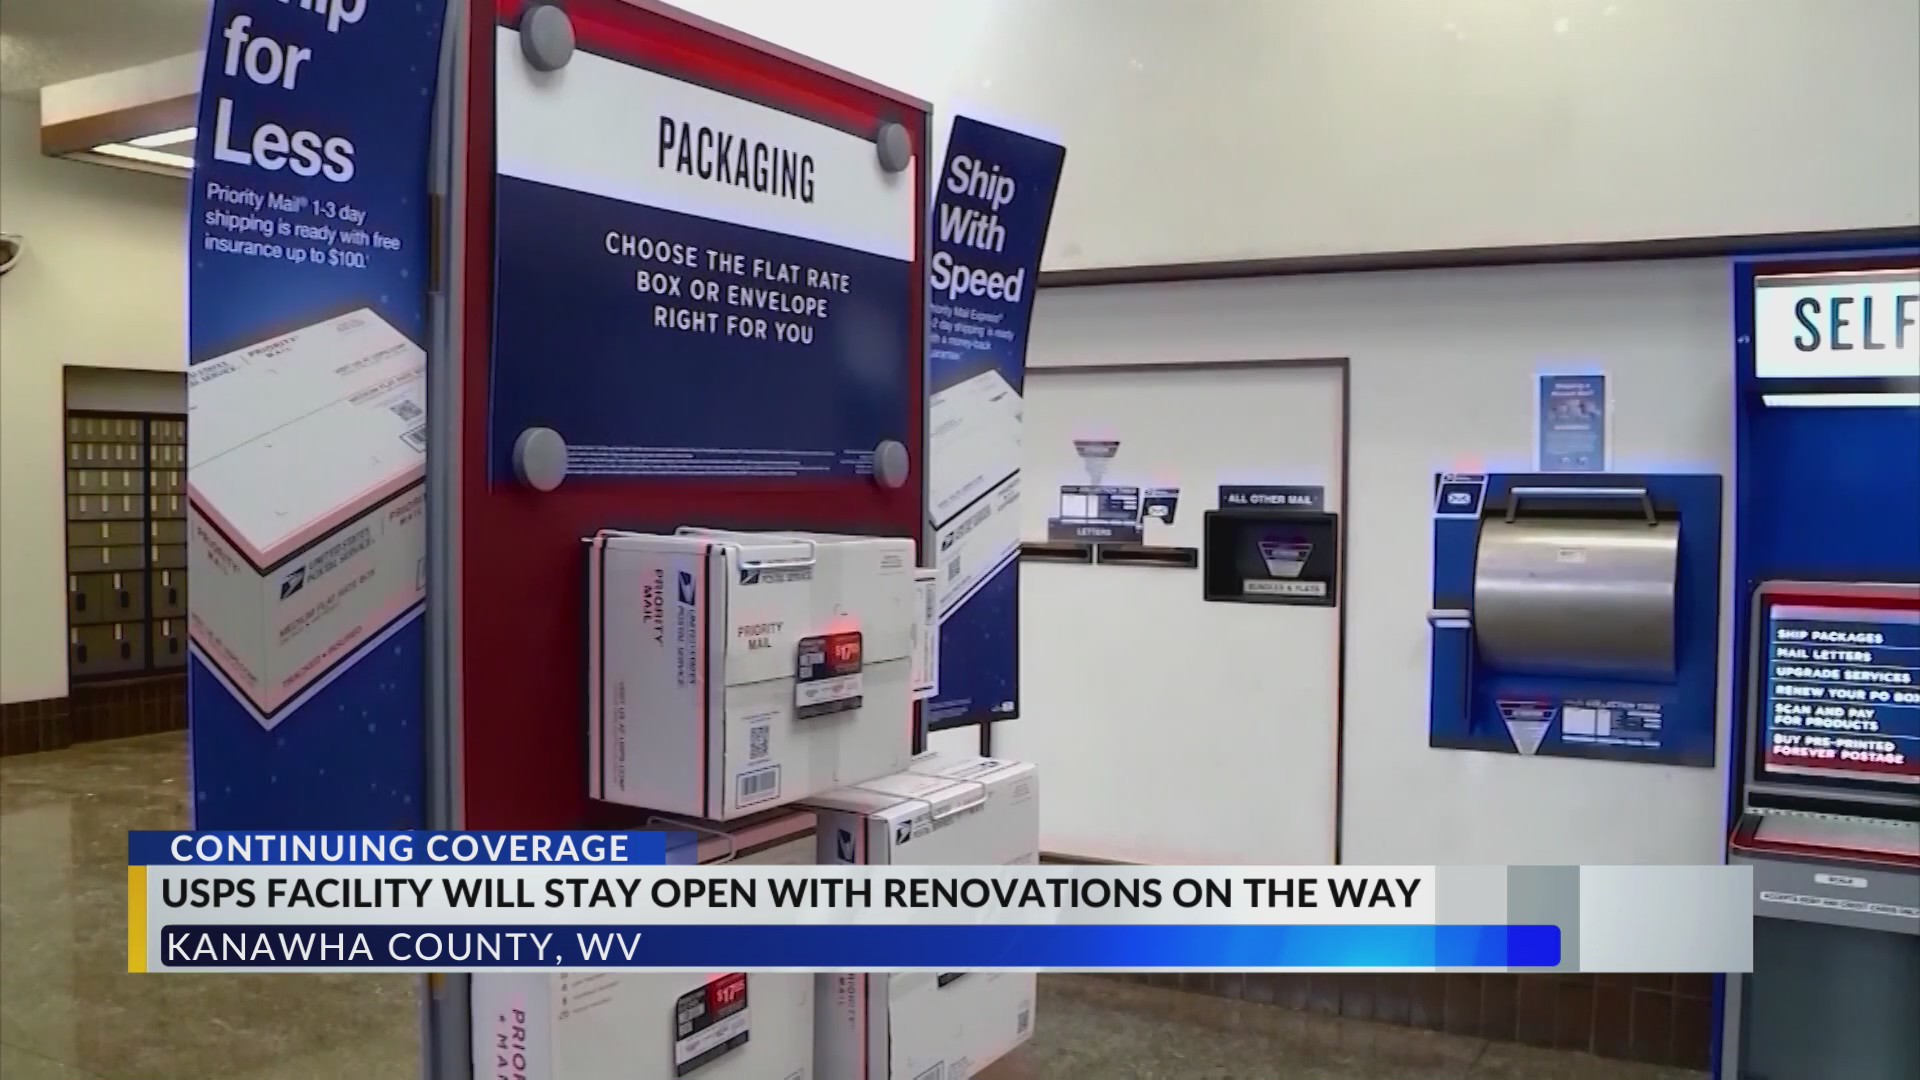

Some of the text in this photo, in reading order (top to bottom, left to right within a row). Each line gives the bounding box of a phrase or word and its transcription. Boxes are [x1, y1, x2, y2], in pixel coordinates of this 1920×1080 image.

[223, 15, 312, 90] for
[214, 98, 355, 182] Less
[658, 115, 815, 204] PACKAGING
[947, 155, 1016, 211] Ship
[206, 182, 264, 211] Priority
[312, 200, 336, 219] 1-3
[338, 205, 367, 226] day
[205, 210, 401, 251] shipping is ready with free
[940, 203, 1006, 252] With
[204, 232, 283, 258] insurance
[285, 247, 307, 265] up
[309, 247, 326, 264] to
[605, 231, 851, 294] CHOOSE THE FLAT RATE
[637, 270, 829, 318] BOX OR ENVELOPE
[930, 251, 1025, 302] Speed
[654, 305, 815, 344] RIGHT FOR YOU
[1794, 294, 1920, 352] SELF
[1227, 493, 1313, 506] ALL OTHER MAIL
[653, 568, 664, 646] PRIORITY
[738, 621, 784, 638] PRIORITY
[748, 638, 773, 650] MAIL
[1776, 629, 1884, 645] SHIP PACKAGES
[1776, 647, 1872, 663] MAIL LETTERS
[1775, 666, 1912, 684] UPGRADE SERVICES
[1775, 685, 1825, 698] RENEW
[1828, 688, 1867, 701] YOUR
[1869, 691, 1891, 702] PO
[1773, 702, 1875, 719] SCAN AND PAY
[1773, 714, 1879, 733] FOR PRODUCTS
[1772, 732, 1896, 753] BUY PRE-PRINTED
[1772, 745, 1905, 765] FOREVER POSTAGE
